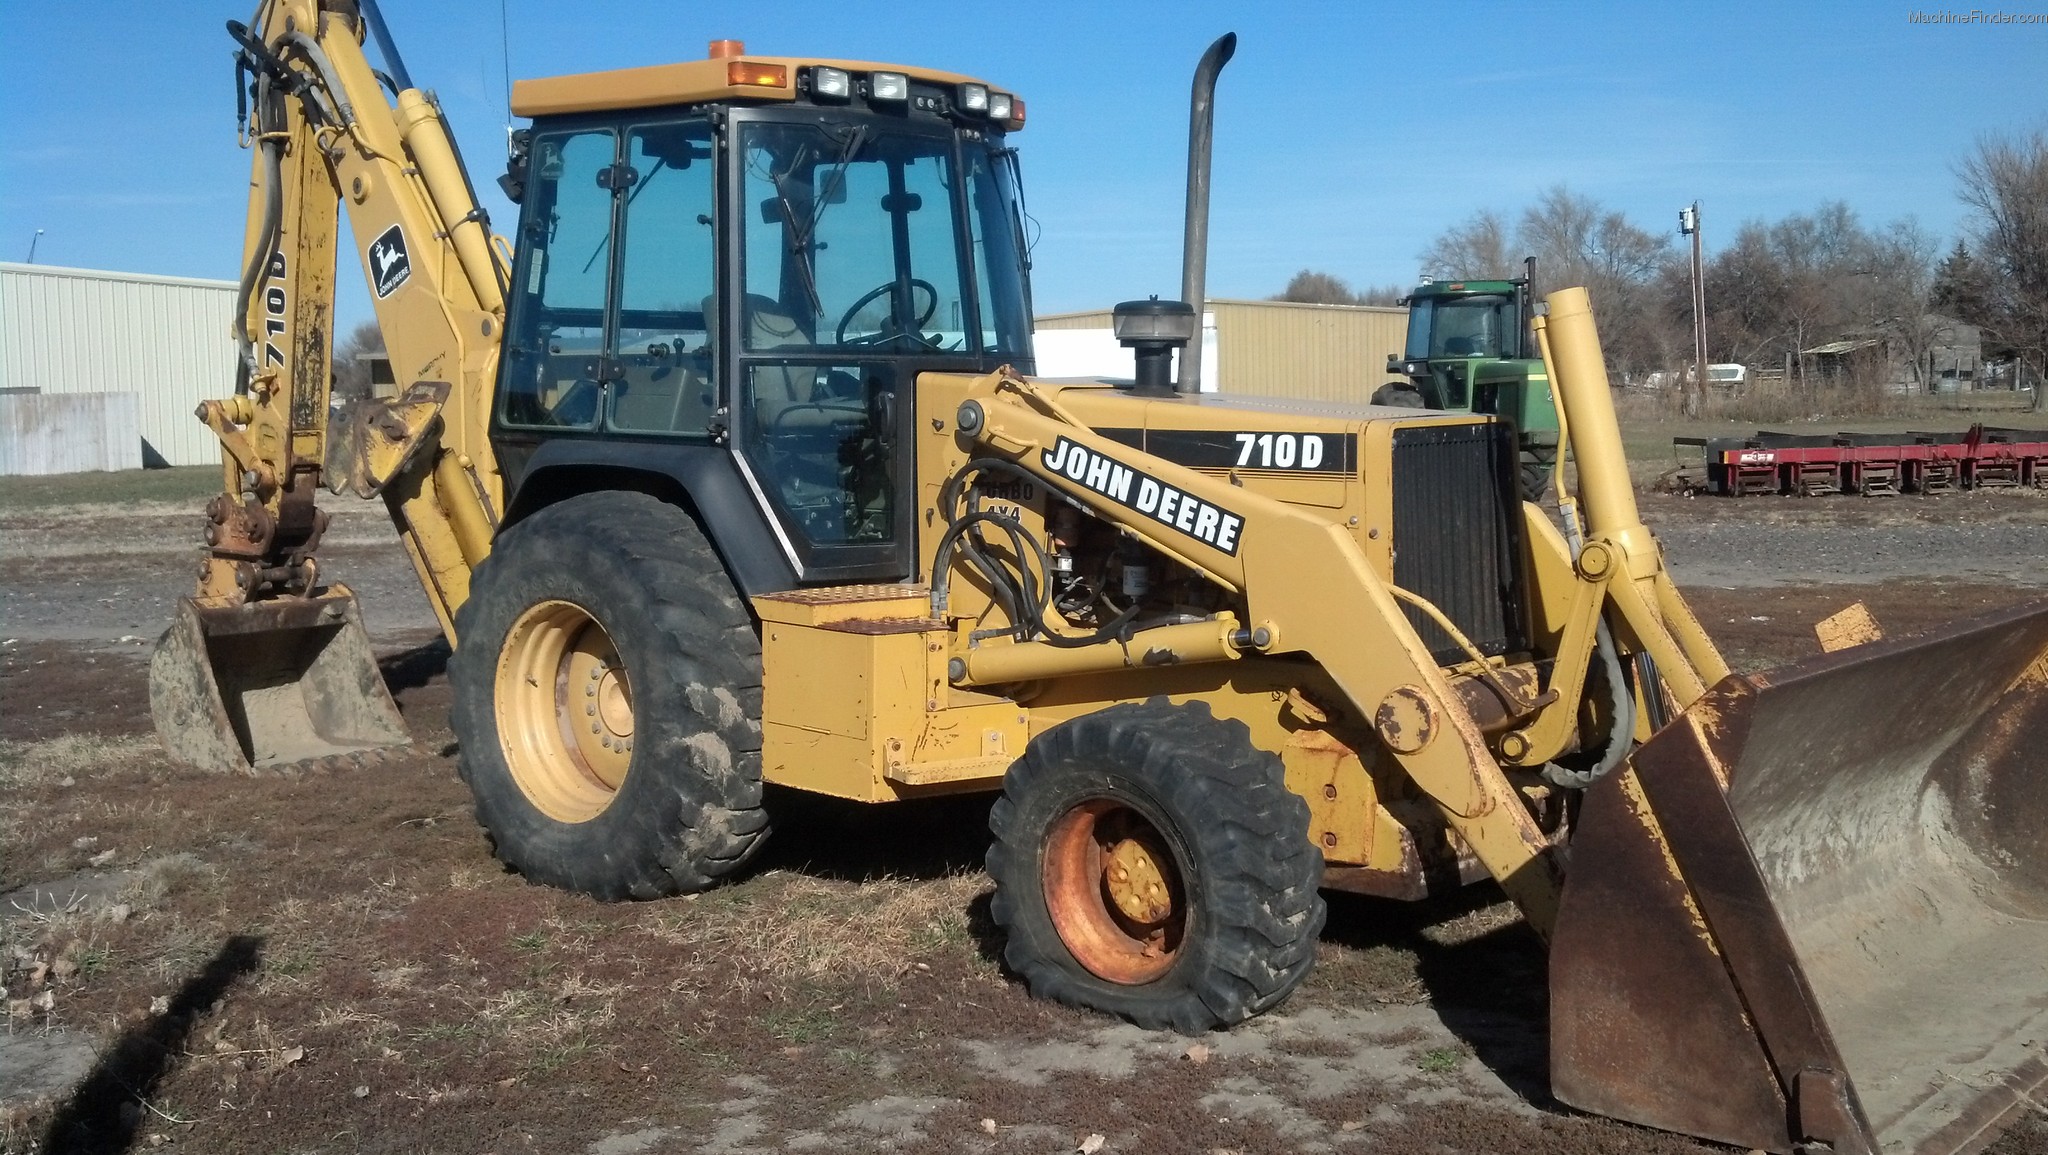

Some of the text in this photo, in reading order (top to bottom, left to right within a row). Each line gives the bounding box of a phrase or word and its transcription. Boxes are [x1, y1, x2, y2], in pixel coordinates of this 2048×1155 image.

[379, 266, 410, 296] JOHN DEERE
[265, 287, 286, 369] 710
[1235, 433, 1297, 468] 710
[1045, 440, 1240, 552] JOHN DEERE
